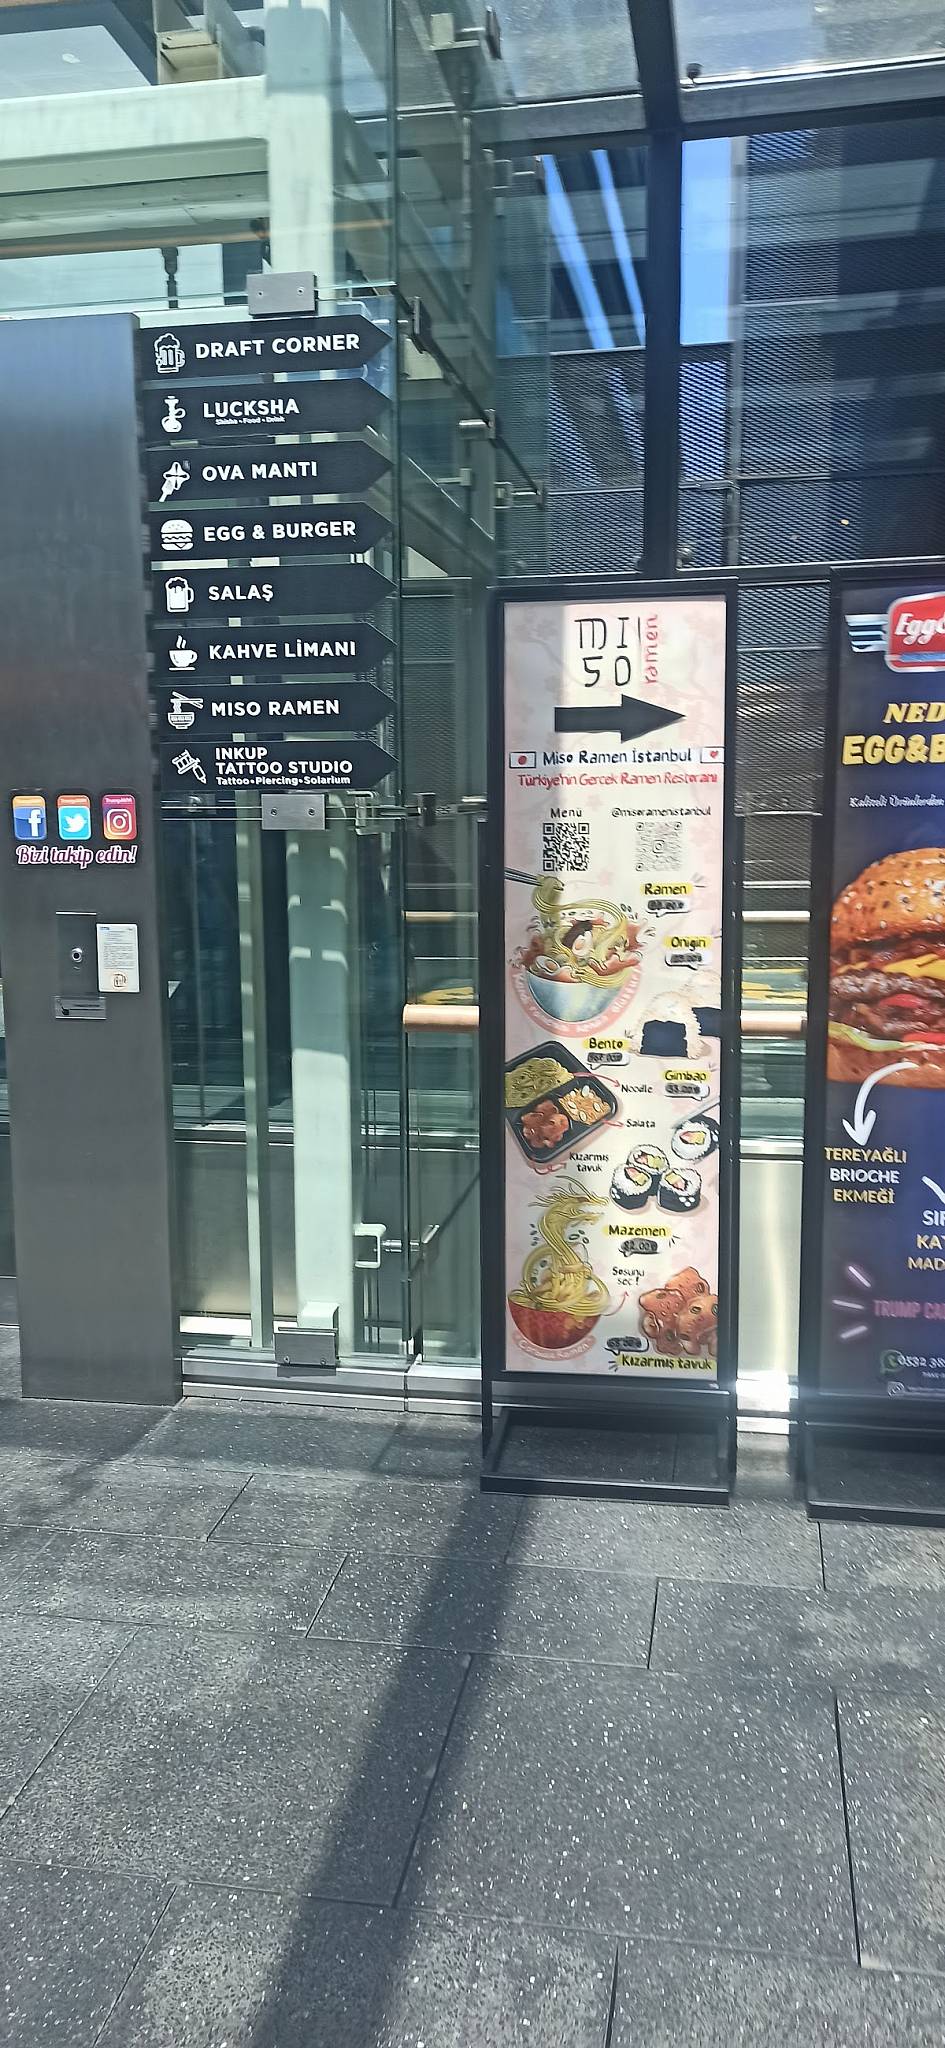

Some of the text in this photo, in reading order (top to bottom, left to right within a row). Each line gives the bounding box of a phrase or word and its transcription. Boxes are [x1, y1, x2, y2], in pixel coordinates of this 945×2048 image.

[195, 333, 360, 360] DRAFT CORNER
[203, 398, 300, 418] LUCKSHA
[202, 461, 318, 482] OVA MANTI
[203, 520, 356, 543] EGG & BURGER
[208, 584, 274, 602] SALAŞ
[208, 638, 356, 661] KAHVE LİMANI
[644, 613, 659, 685] ramen
[211, 699, 340, 717] MISO RAMEN
[215, 747, 268, 761] INKUP
[542, 747, 692, 766] Miso Ramen İstanbul
[215, 760, 353, 775] TATTOO STUDIO
[550, 806, 583, 819] Menü
[16, 844, 138, 870] Bizi takip edin!
[644, 882, 687, 896] Ramen
[589, 1036, 623, 1049] Bento
[621, 1083, 653, 1094] Noodle
[626, 1118, 656, 1129] Salata
[824, 1146, 907, 1164] TEREYAĞLI
[577, 1163, 603, 1172] tavuk
[829, 1167, 900, 1184] BRIOCHE
[833, 1187, 895, 1204] EKMEĞİ
[608, 1224, 667, 1237] Mazemen
[915, 1233, 945, 1250] KA
[621, 1353, 713, 1371] Kızarmış tavuk
